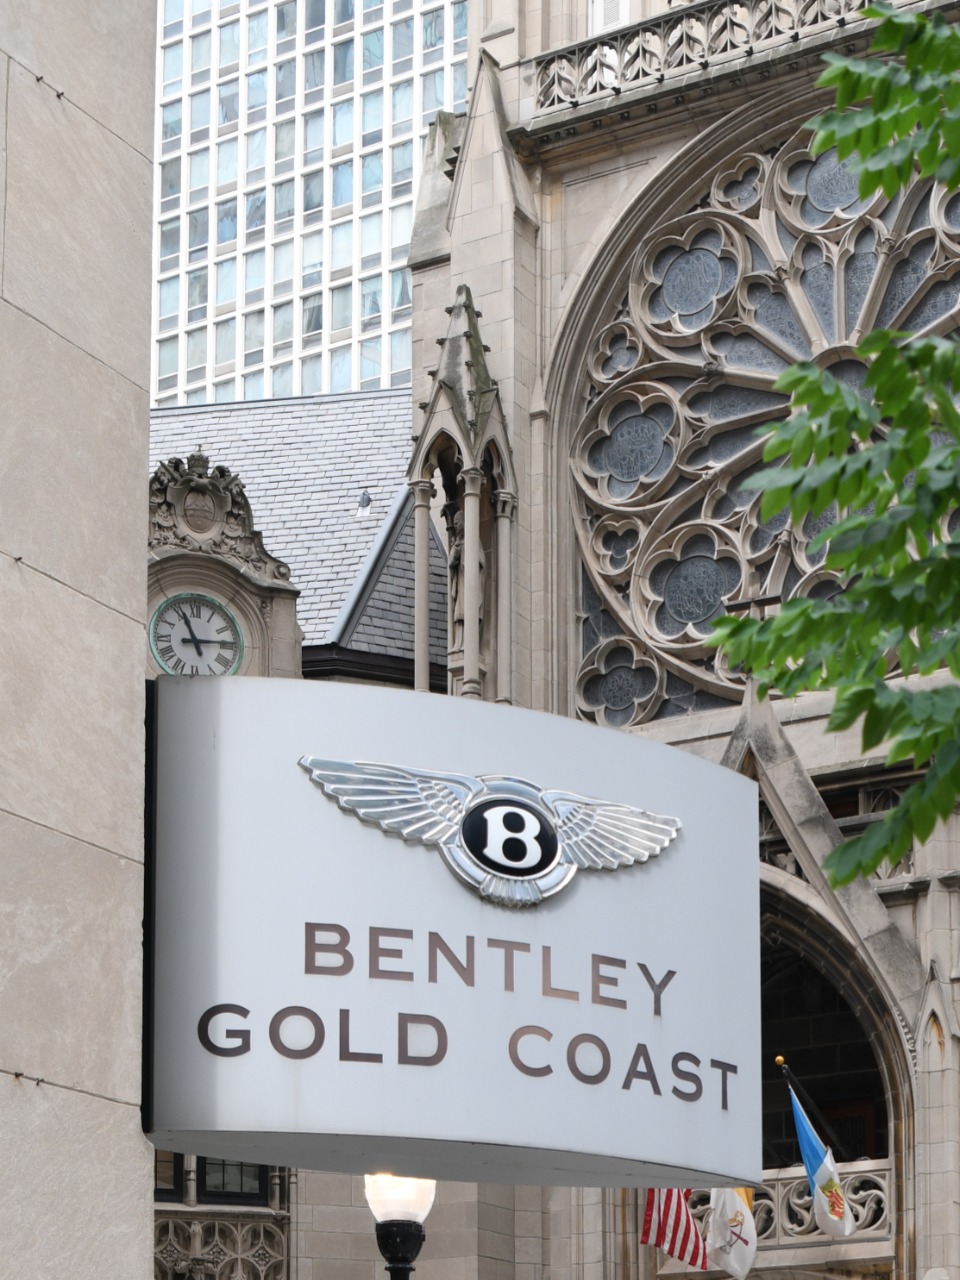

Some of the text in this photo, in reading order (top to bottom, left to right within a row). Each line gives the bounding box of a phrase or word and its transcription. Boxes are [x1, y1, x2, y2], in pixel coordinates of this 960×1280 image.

[482, 805, 542, 869] B
[304, 922, 677, 1016] BENTLEY
[196, 1003, 739, 1110] GOLD COAST
